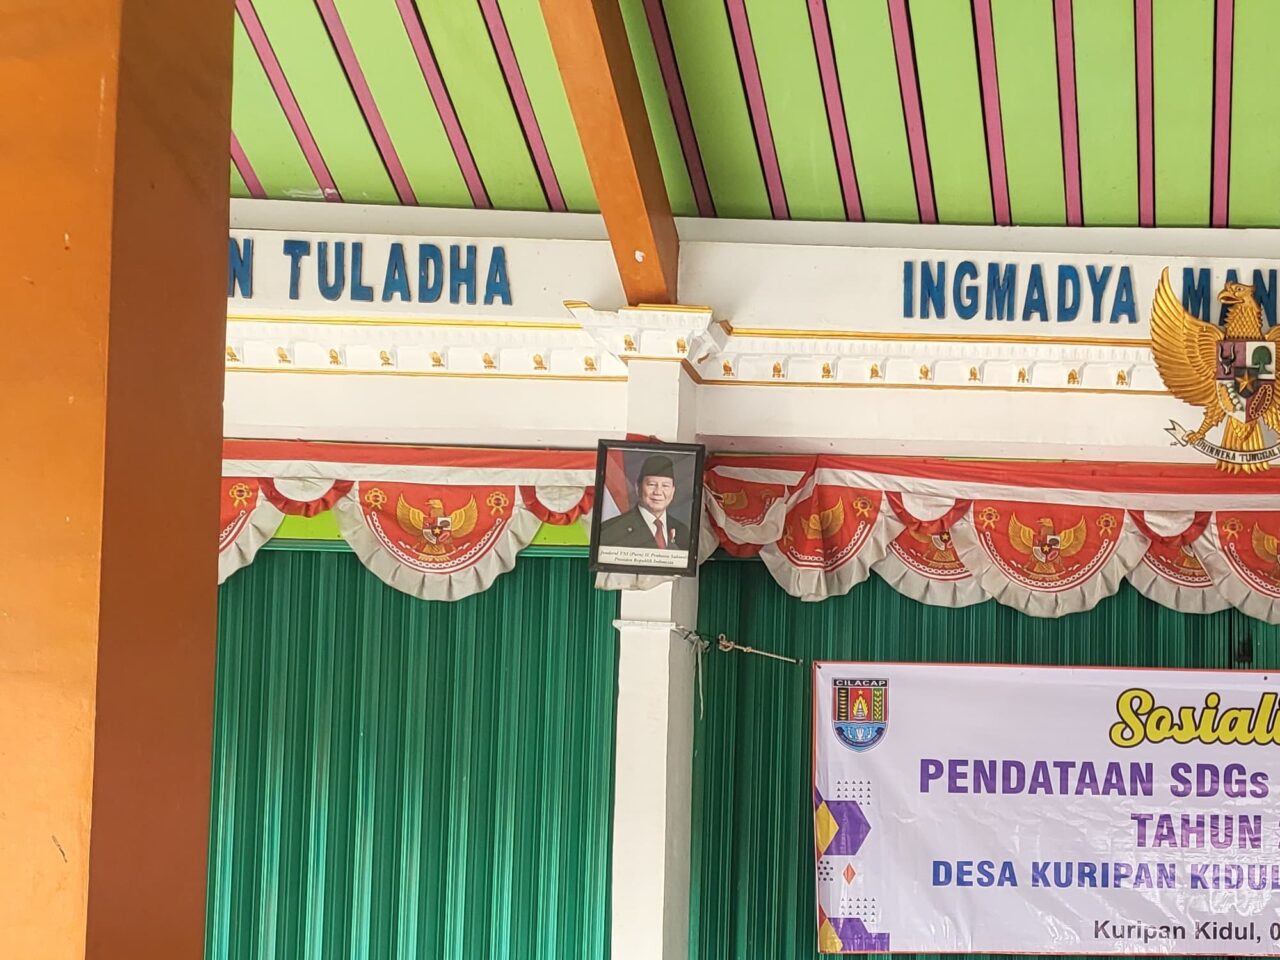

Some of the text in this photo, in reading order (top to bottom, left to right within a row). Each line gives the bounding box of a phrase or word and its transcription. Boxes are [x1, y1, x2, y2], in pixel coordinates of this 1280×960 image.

[283, 239, 512, 305] TULADHA
[903, 260, 1139, 324] INGMADYA
[919, 758, 1154, 797] PENDATAAN
[1169, 762, 1269, 799] SDGs
[1130, 813, 1262, 850] TAHUN
[932, 860, 1018, 888] DESA
[1031, 861, 1176, 889] KURIPAN
[1094, 920, 1186, 944] Kuripan
[1195, 920, 1262, 944] Kidul,
